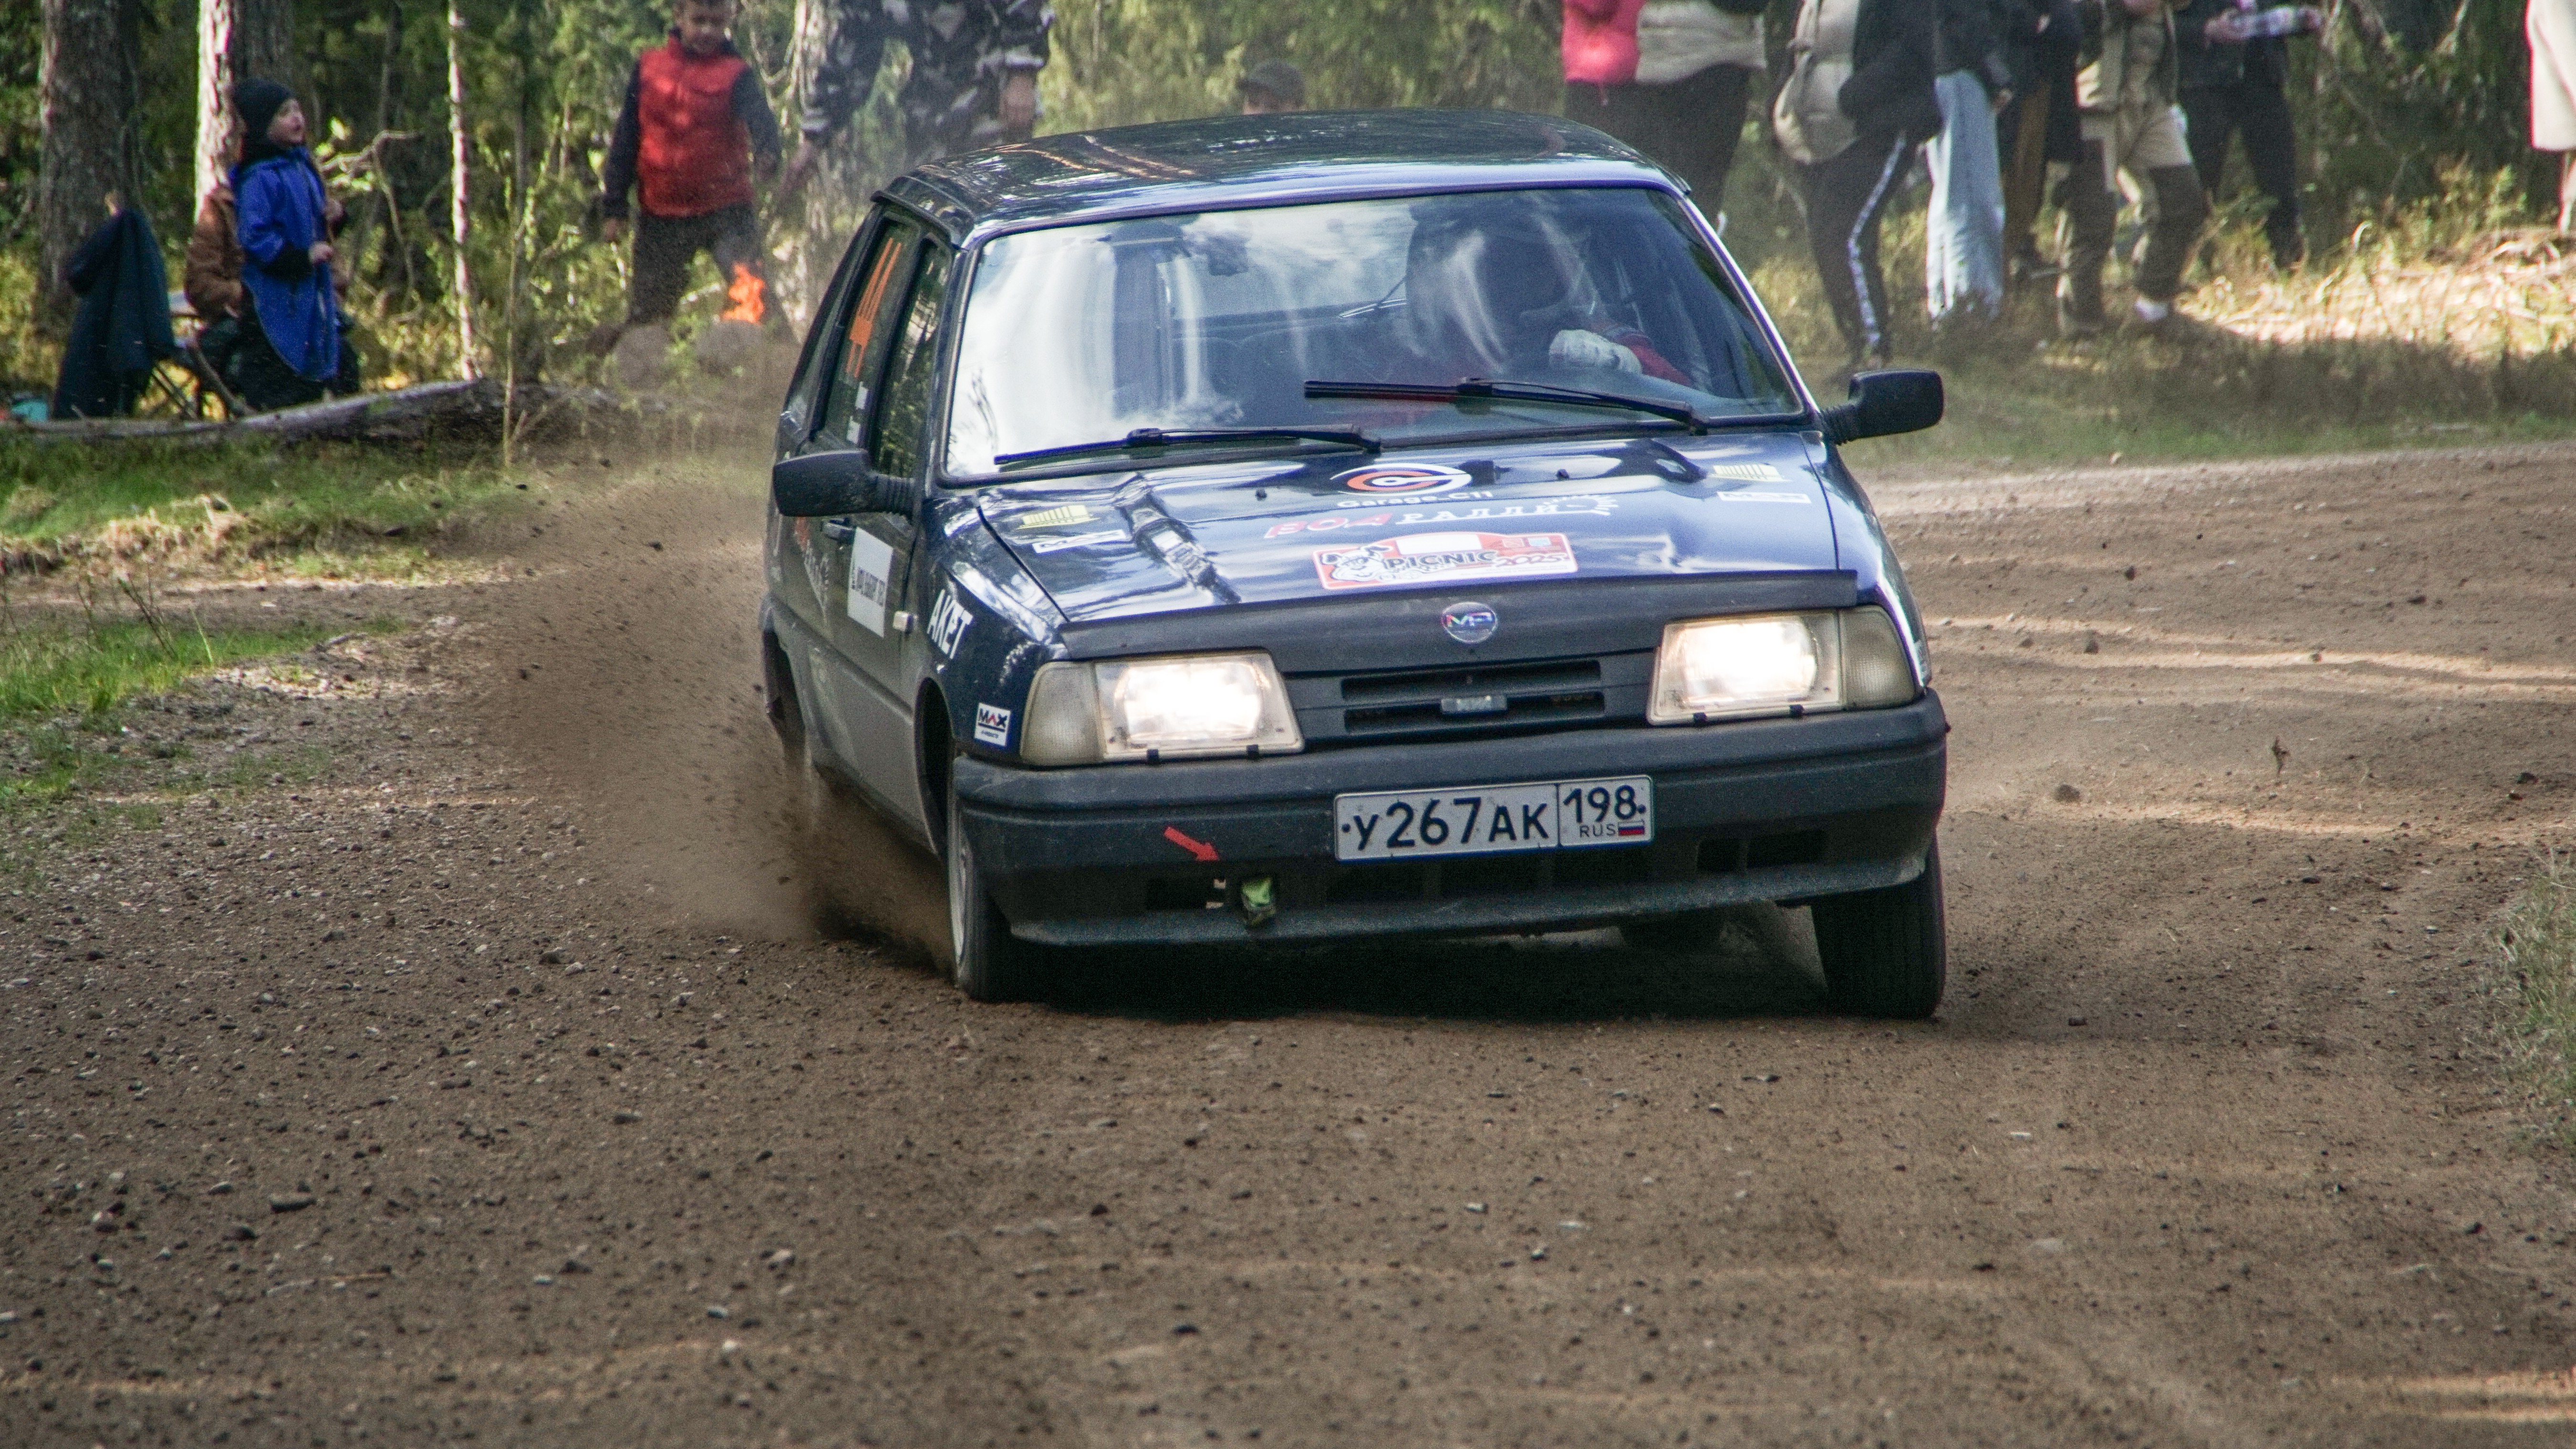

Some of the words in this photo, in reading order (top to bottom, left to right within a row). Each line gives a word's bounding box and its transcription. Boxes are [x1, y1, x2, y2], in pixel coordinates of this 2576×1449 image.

[1386, 550, 1498, 570] PICNIC
[1495, 553, 1568, 569] 2025
[978, 708, 1008, 728] MAX
[1563, 785, 1637, 823] 198
[1579, 824, 1616, 838] RUS
